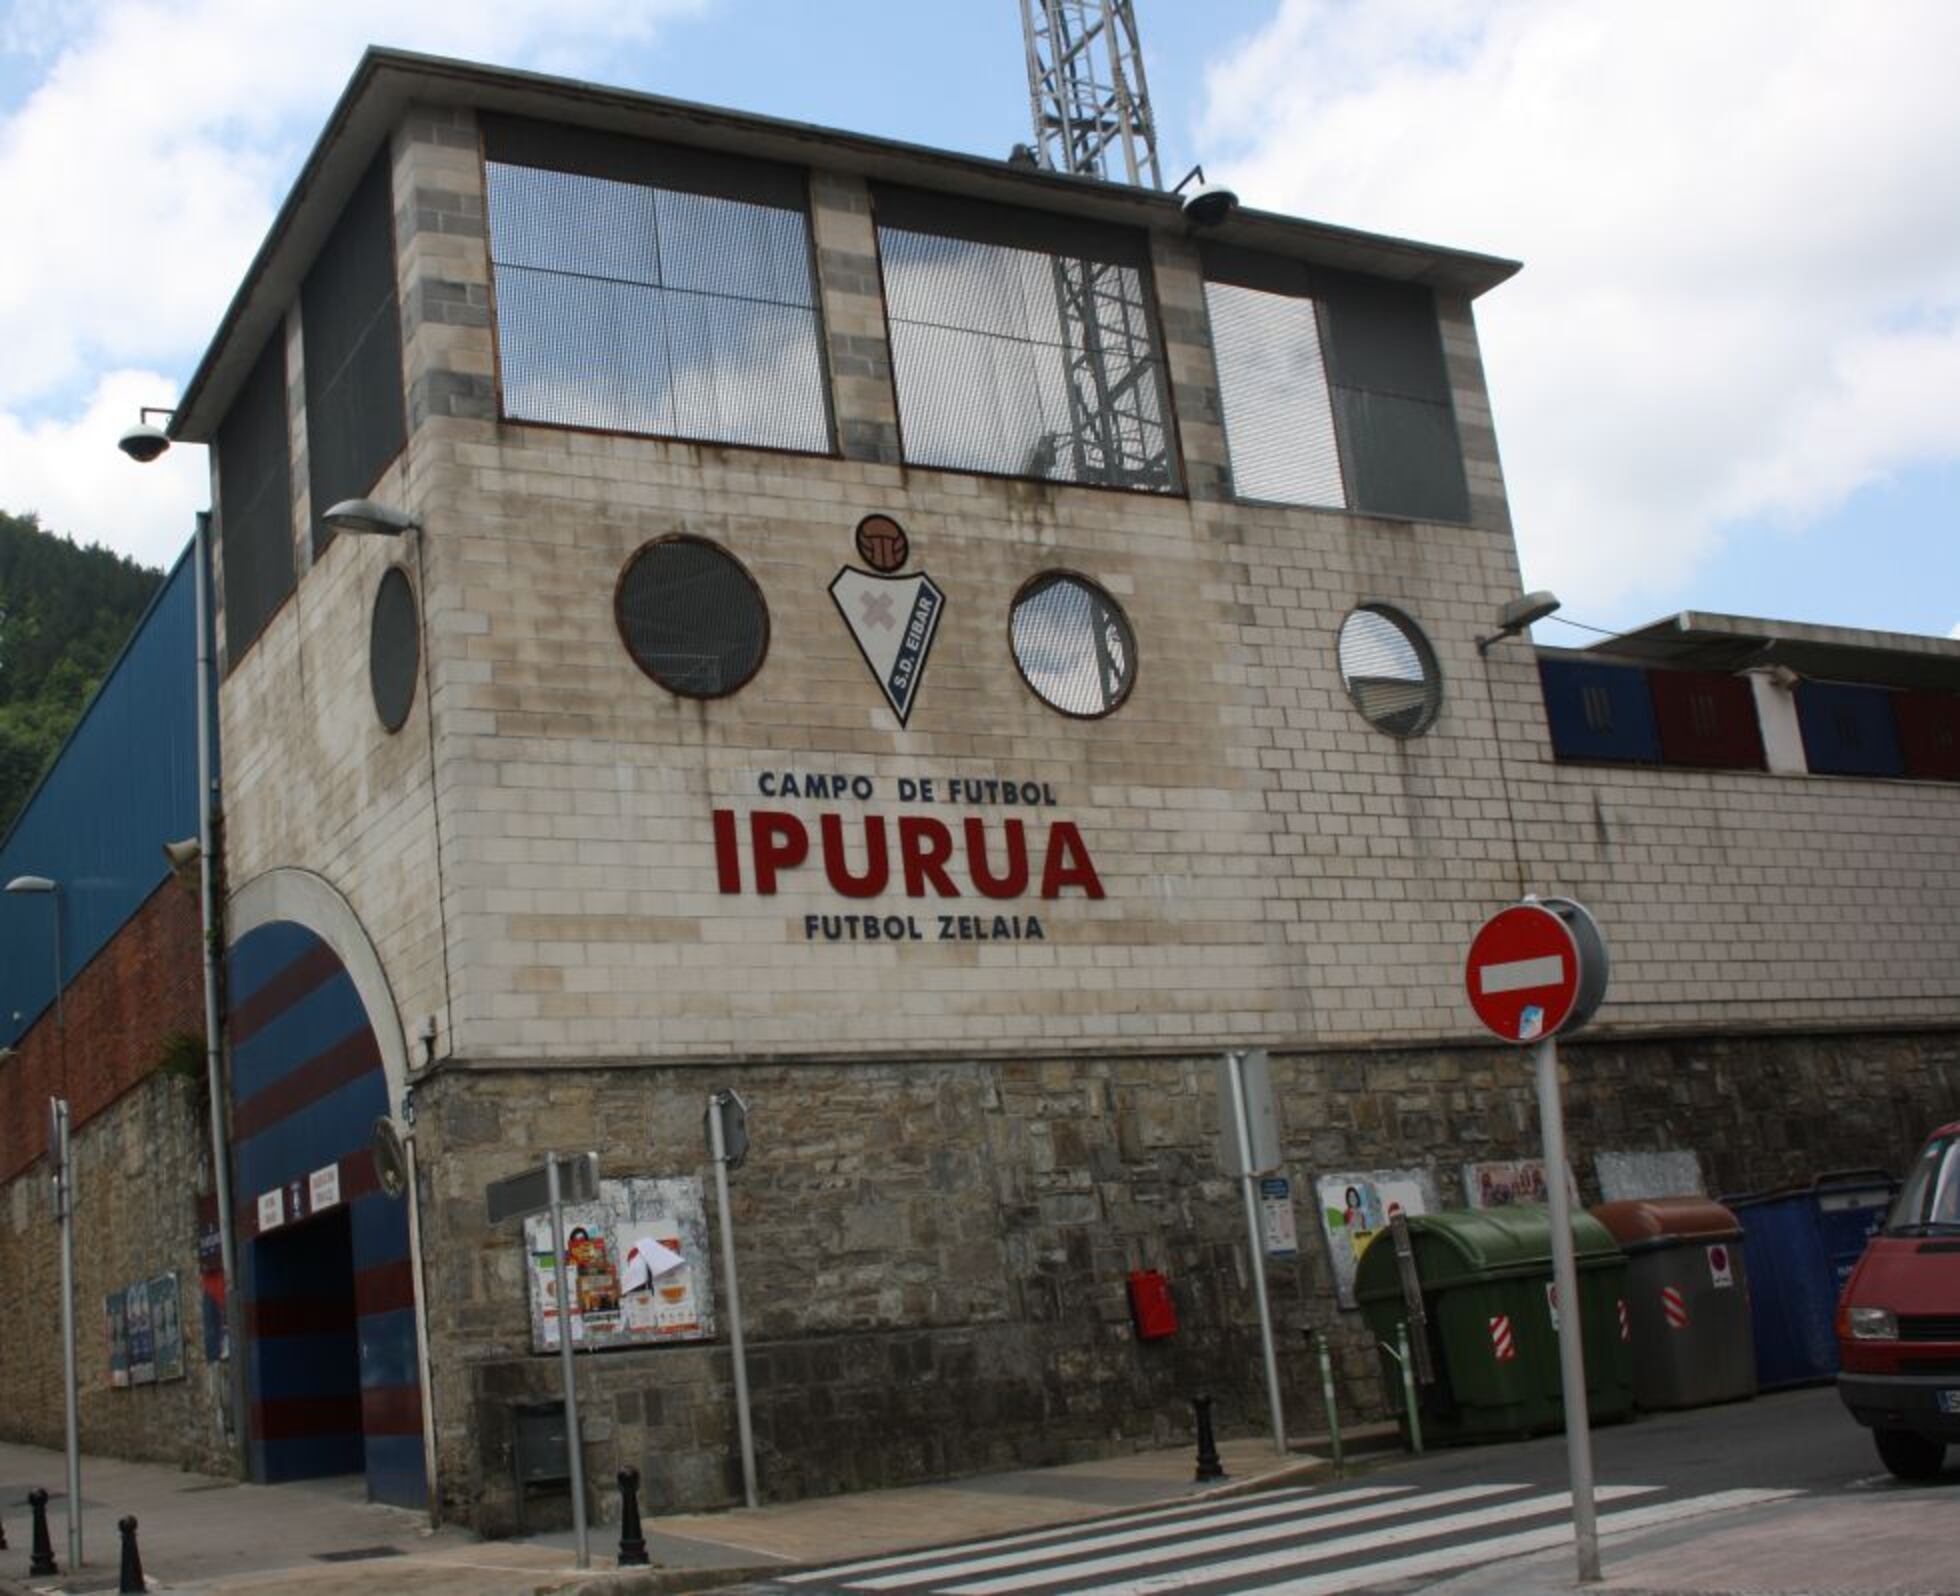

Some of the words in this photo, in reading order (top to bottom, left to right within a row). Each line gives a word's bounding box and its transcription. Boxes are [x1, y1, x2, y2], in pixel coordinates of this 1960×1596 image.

[893, 657, 915, 689] S.D.
[905, 597, 933, 651] EIBAR
[758, 771, 874, 802] CAMPO
[897, 777, 935, 803] DE
[947, 778, 1058, 808] FUTBOL
[714, 810, 1104, 899] IPURUA
[804, 914, 923, 941] FUTBOL
[937, 915, 1046, 942] ZELAIA
